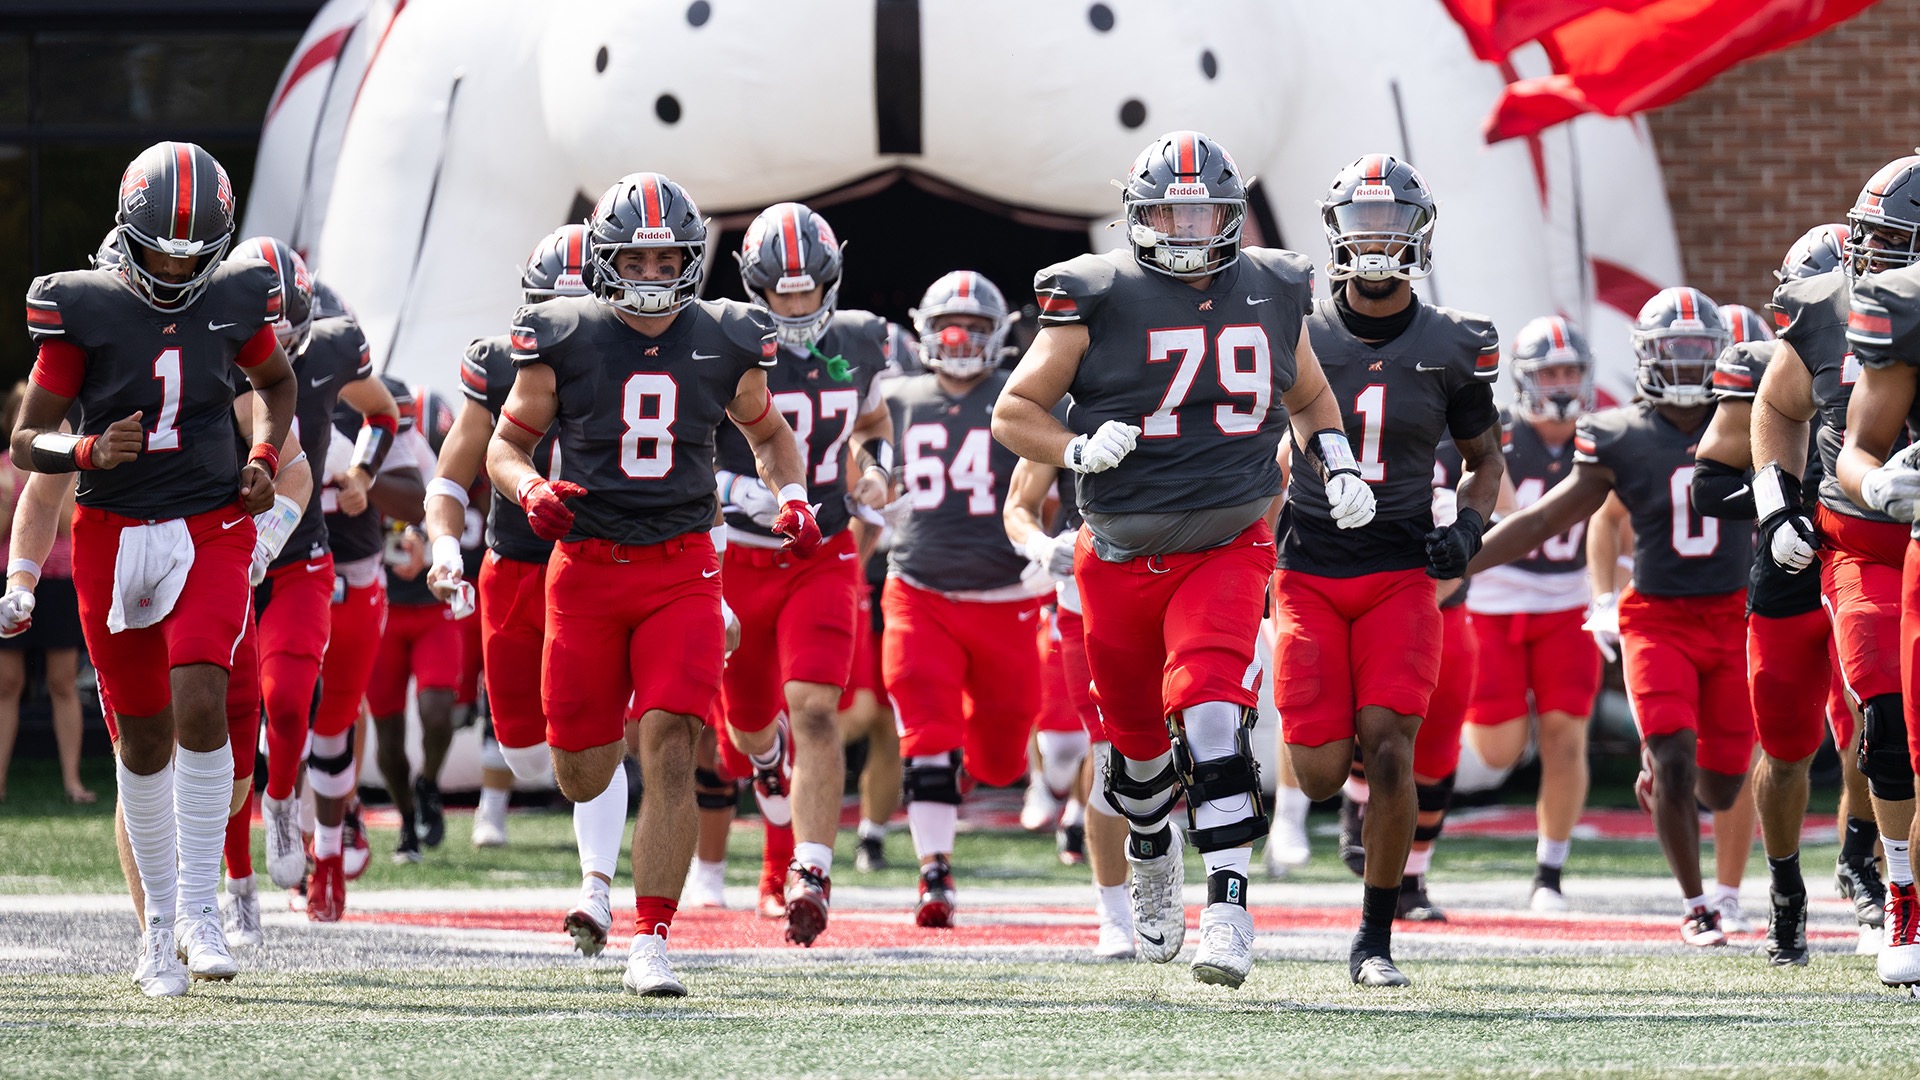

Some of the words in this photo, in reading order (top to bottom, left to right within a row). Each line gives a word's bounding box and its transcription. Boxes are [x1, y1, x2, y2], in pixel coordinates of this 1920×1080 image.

[637, 231, 671, 240] Riddell
[1169, 187, 1205, 195] Riddell
[1356, 188, 1390, 196] Riddell
[145, 346, 184, 454] 1
[618, 372, 679, 480] 8
[1141, 323, 1273, 438] 79
[904, 423, 997, 516] 64
[1353, 383, 1388, 483] 1
